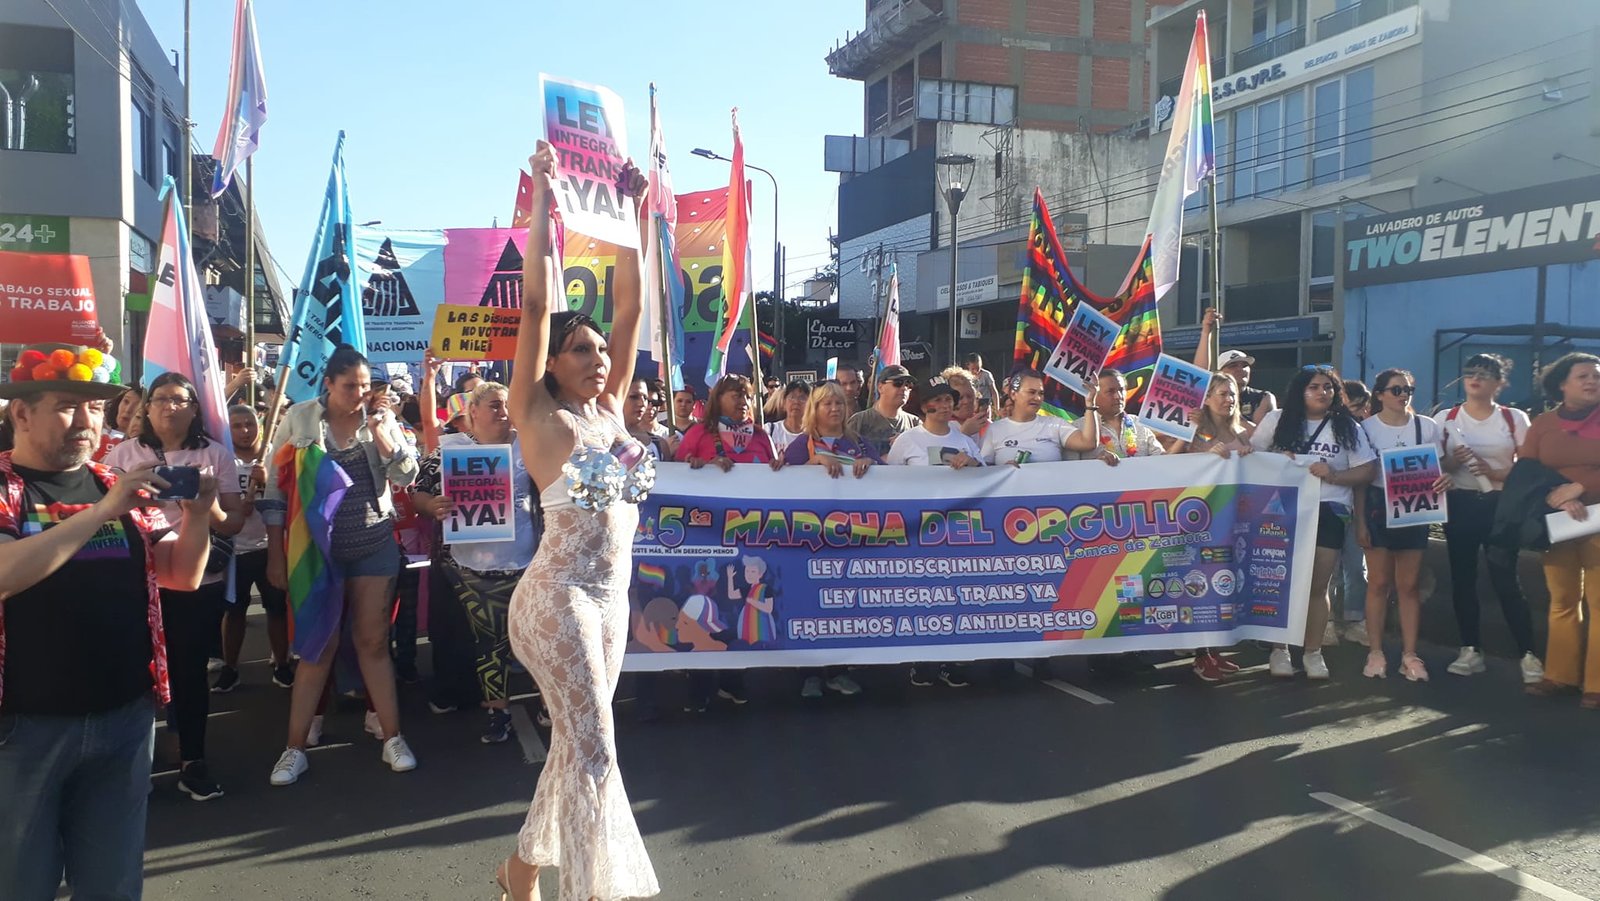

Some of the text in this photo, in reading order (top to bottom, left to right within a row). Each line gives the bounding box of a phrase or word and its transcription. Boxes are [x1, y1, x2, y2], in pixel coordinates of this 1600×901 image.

[1366, 205, 1484, 235] LAVADERO DE AUTOS
[47, 288, 91, 297] SEXUAL
[8, 297, 95, 312] TRABAJO
[448, 311, 479, 323] LAS
[1076, 314, 1111, 339] LEY
[462, 326, 475, 337] NO
[811, 336, 854, 349] Disco
[442, 338, 450, 351] A
[1066, 338, 1100, 364] TRANS
[1162, 364, 1202, 387] LEY
[1154, 388, 1197, 410] TRANS
[451, 456, 501, 476] LEY
[1391, 454, 1430, 473] LEY
[449, 478, 505, 487] INTEGRAL
[449, 489, 505, 502] TRANS
[1393, 493, 1439, 519] ¡YA!
[451, 503, 506, 532] ¡YA!
[722, 508, 909, 551] MARCHA
[918, 509, 995, 546] DEL
[1002, 497, 1212, 547] ORGULLO
[1063, 531, 1211, 560] Lomas de Zamora
[809, 554, 1067, 578] LEY ANTIDISCRIMINATORIA
[821, 582, 1058, 607] LEY INTEGRAL TRANS YA
[790, 618, 894, 640] FRENEMOS
[897, 615, 914, 635] A
[916, 614, 953, 634] LOS
[957, 609, 1098, 633] ANTIDERECHO
